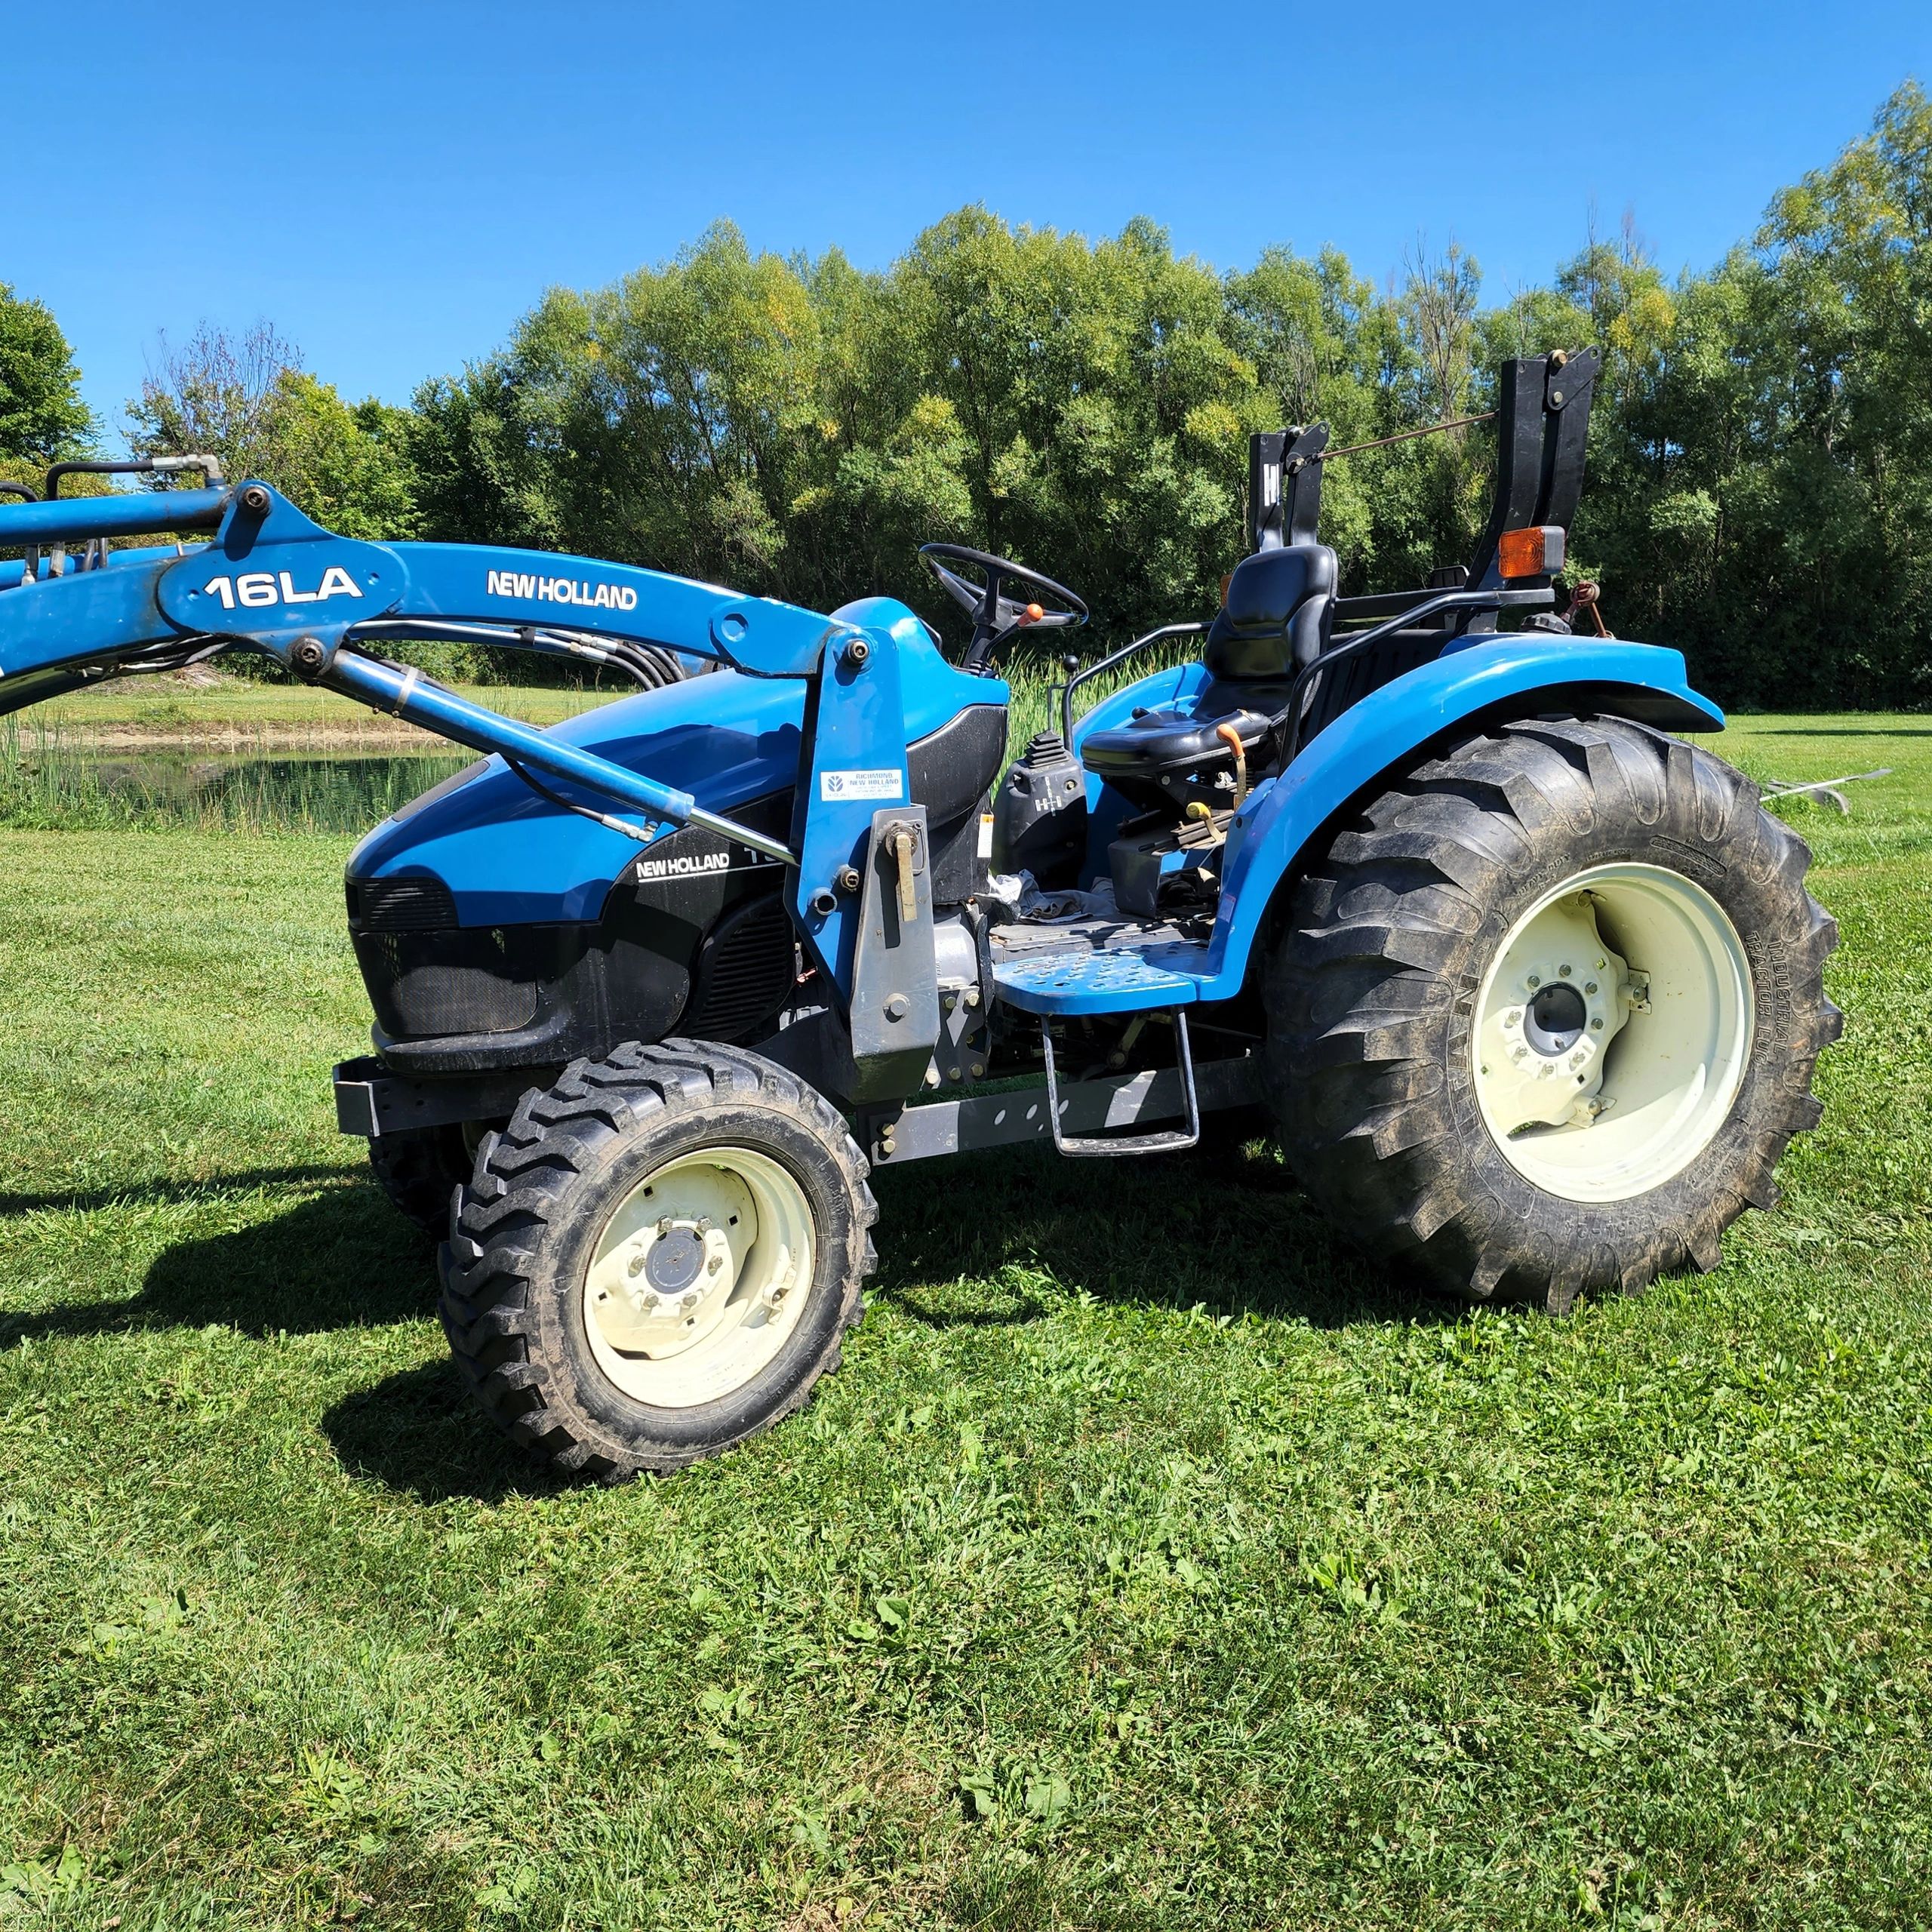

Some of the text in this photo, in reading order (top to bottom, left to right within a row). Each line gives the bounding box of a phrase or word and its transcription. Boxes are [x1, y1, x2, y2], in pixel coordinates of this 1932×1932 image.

[204, 567, 366, 610] 16LA
[487, 570, 638, 611] NEW HOLLAND
[636, 853, 730, 878] NEW HOLLAND
[1745, 931, 1773, 1065] TRACTOR LUG
[1768, 941, 1792, 1054] INDUSTRIAL
